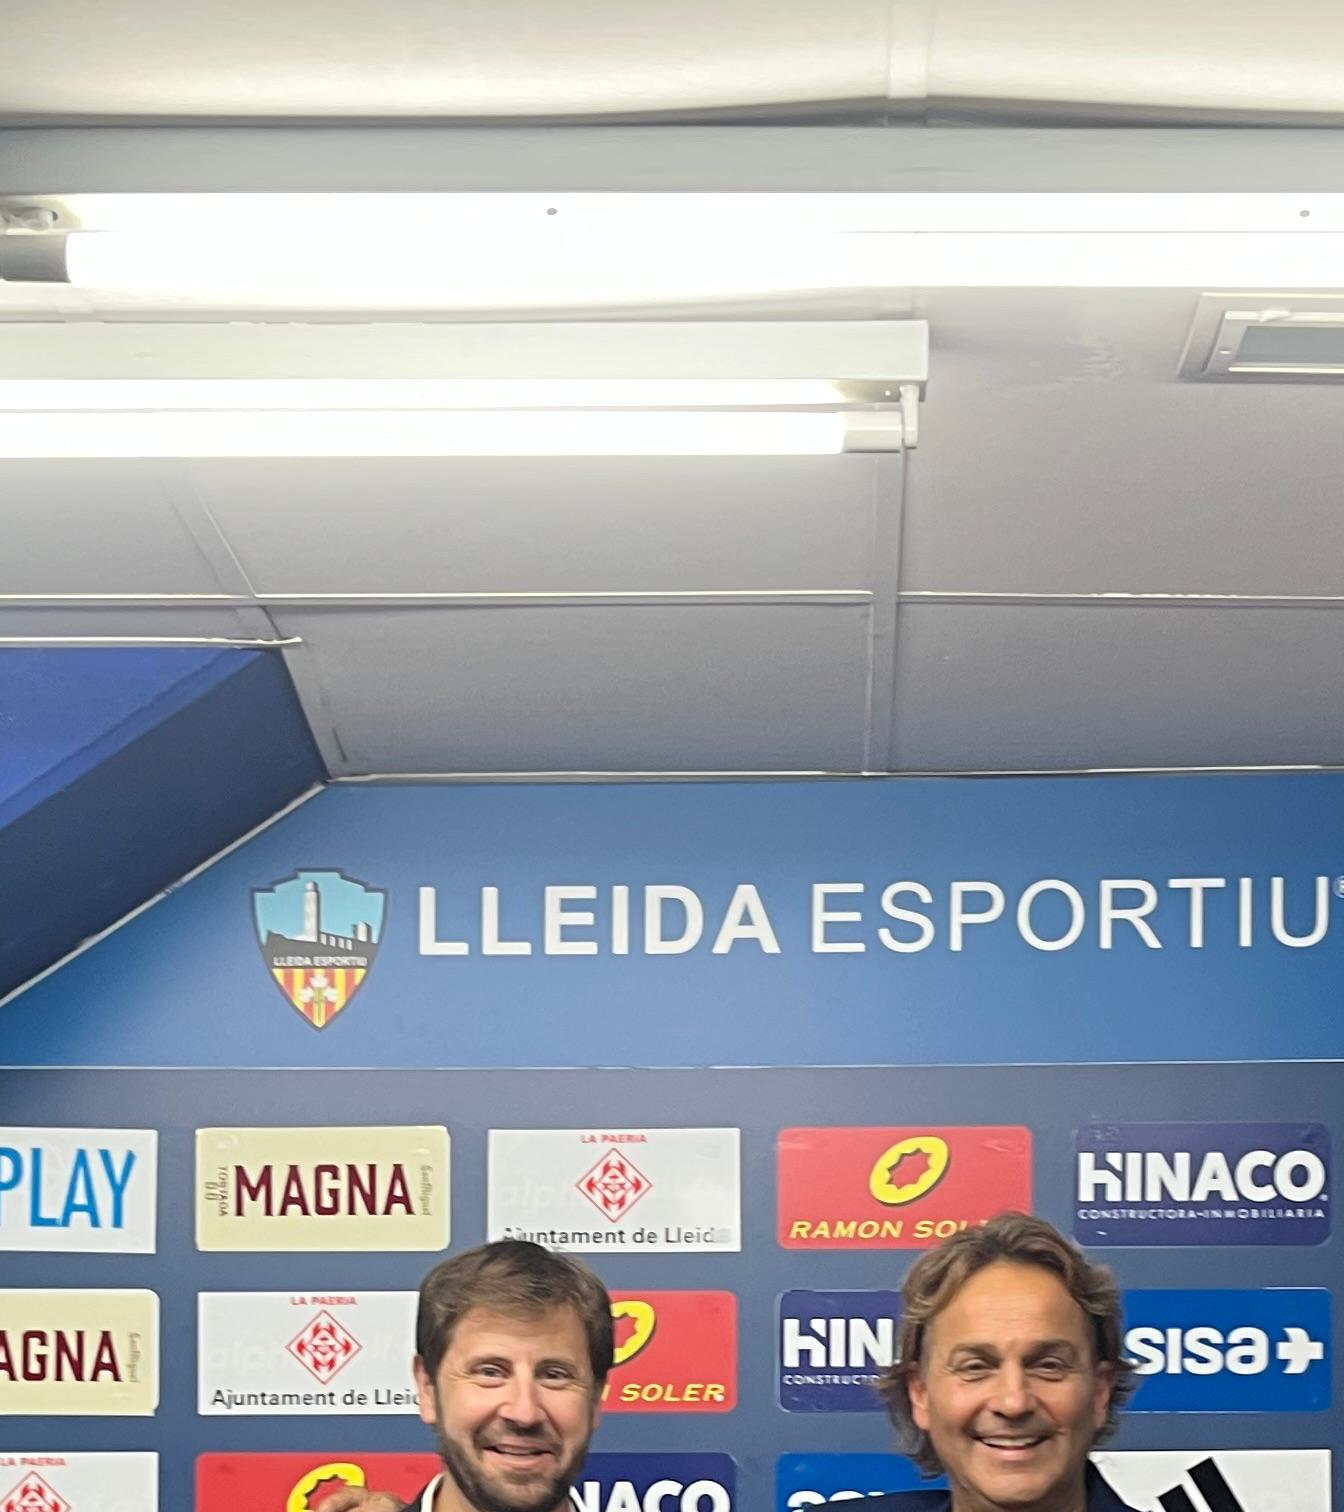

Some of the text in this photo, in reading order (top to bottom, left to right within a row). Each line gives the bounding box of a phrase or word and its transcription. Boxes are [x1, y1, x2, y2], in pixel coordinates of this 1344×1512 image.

[420, 885, 781, 955] LLEIDA
[235, 1164, 414, 1216] MAGNA
[1079, 1151, 1327, 1203] HINACO
[633, 1228, 657, 1243] de
[790, 1219, 903, 1240] RAMON
[782, 1318, 894, 1368] HIN
[1124, 1326, 1269, 1375] sisa
[212, 1390, 335, 1409] Ajuntament
[343, 1389, 367, 1405] de
[620, 1384, 724, 1401] SOLER
